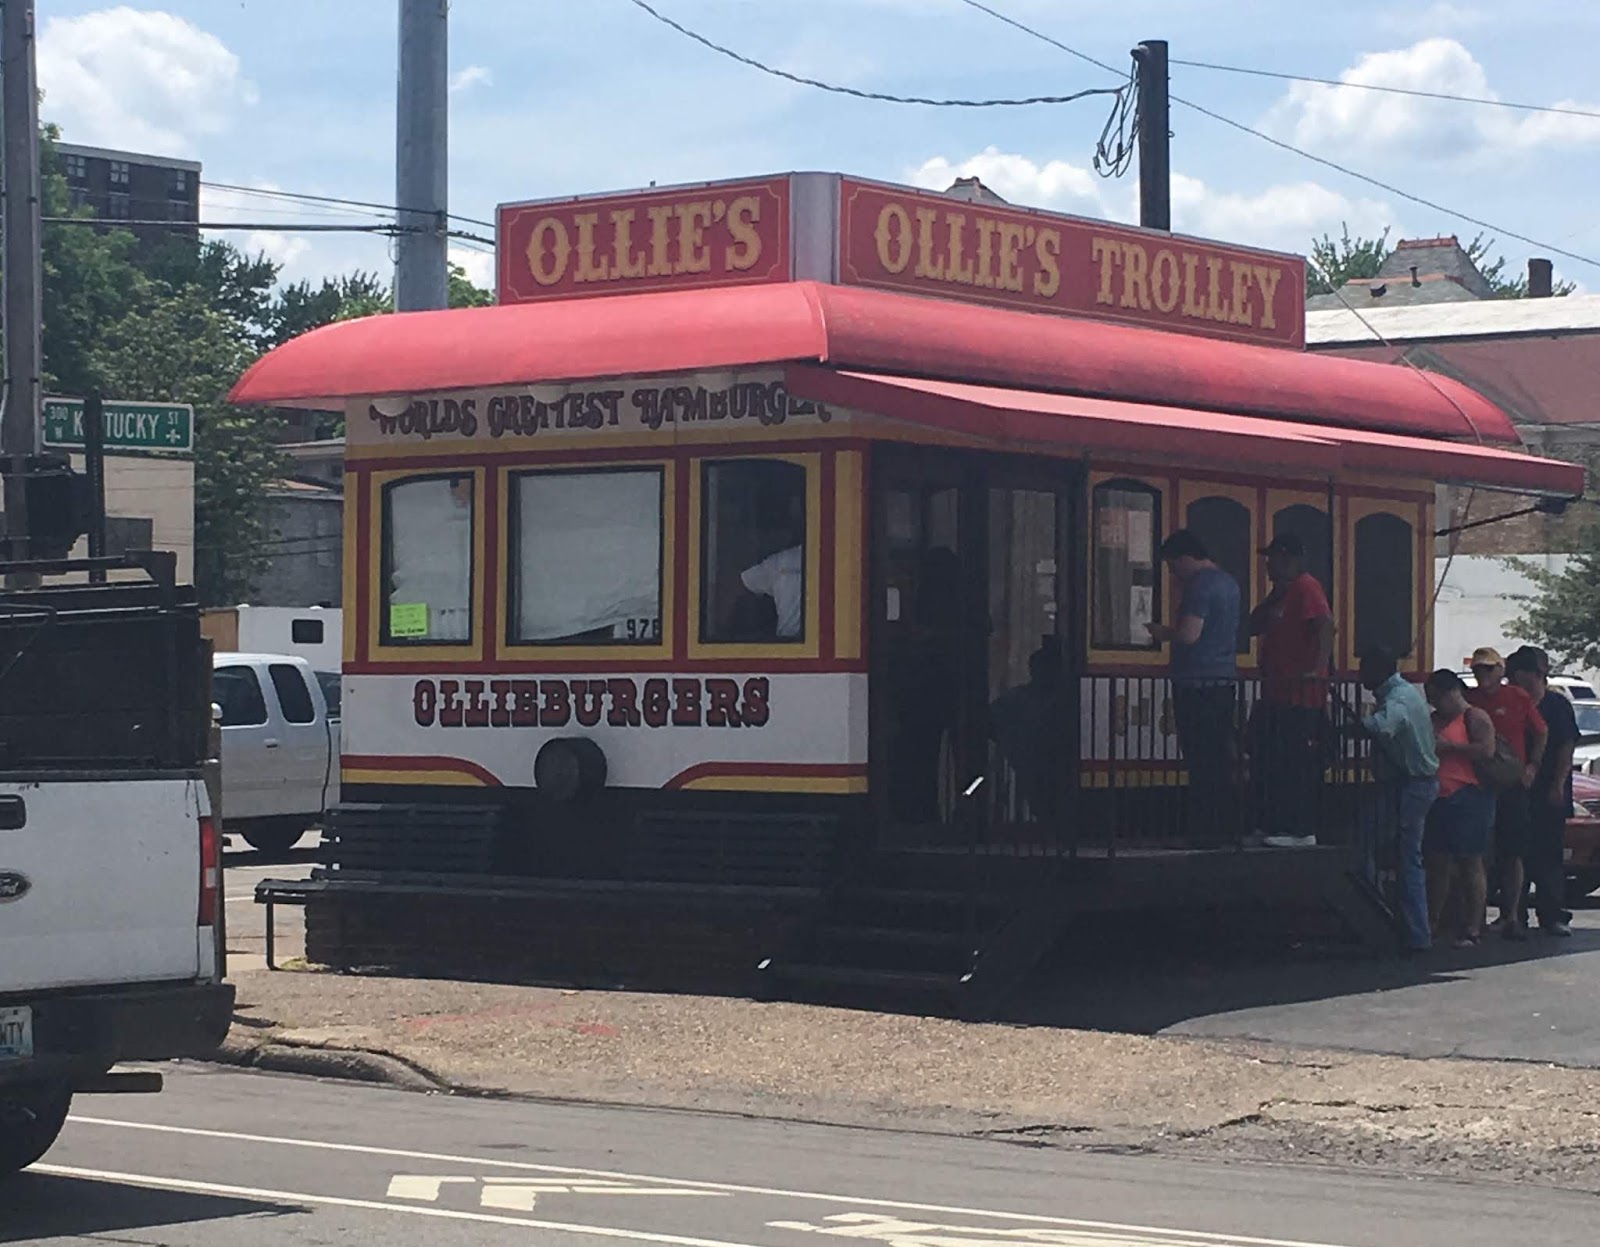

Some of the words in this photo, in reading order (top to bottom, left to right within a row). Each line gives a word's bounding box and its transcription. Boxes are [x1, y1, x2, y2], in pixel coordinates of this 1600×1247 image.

[526, 196, 762, 285] OLLIE'S
[874, 203, 1061, 297] OLLIE'S
[1092, 237, 1281, 329] TROLLEY
[74, 411, 159, 439] KTUCKY
[168, 411, 178, 425] ST
[488, 390, 624, 437] GREATEST
[413, 677, 770, 728] OLLIEBURGERS
